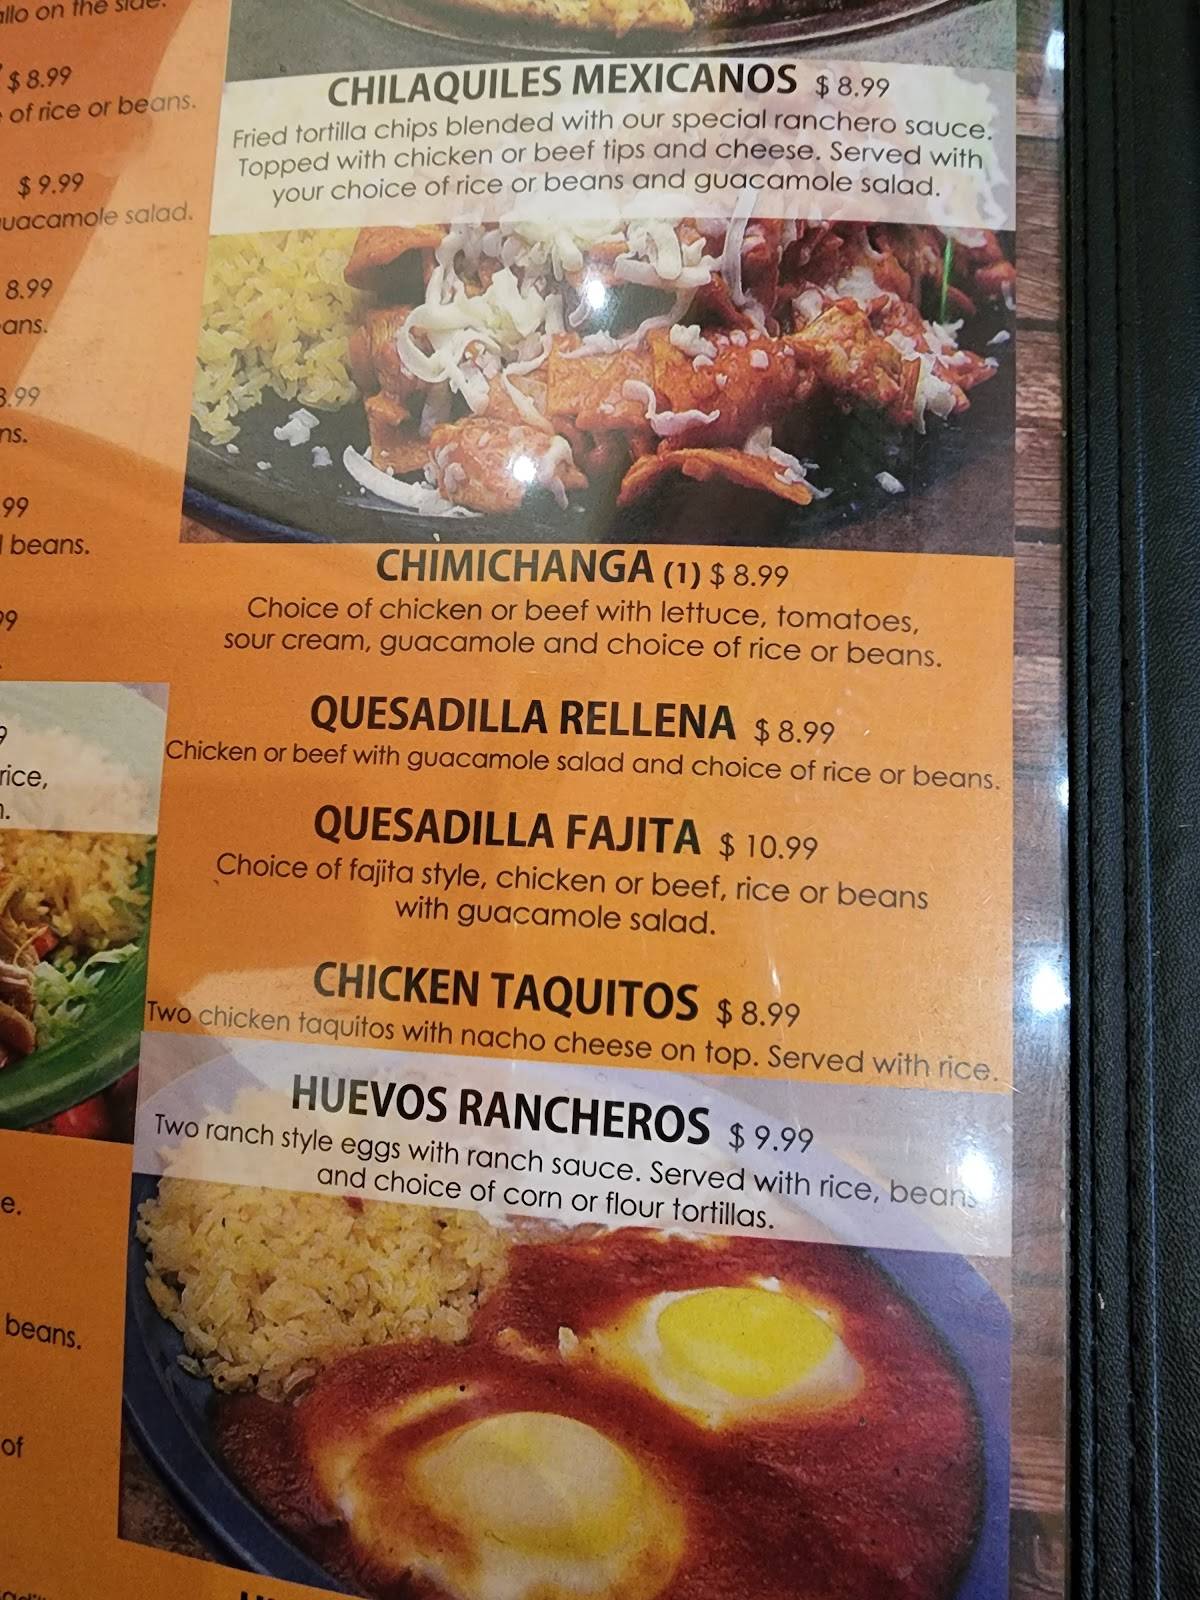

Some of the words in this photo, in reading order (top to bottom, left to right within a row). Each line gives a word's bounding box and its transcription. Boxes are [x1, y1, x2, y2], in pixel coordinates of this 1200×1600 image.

[35, 2, 64, 21] on
[72, 0, 107, 16] the
[7, 70, 21, 93] $
[26, 65, 72, 89] 8.99
[327, 65, 562, 107] CHILAQUILES
[572, 63, 797, 96] MEXICANOS
[815, 75, 829, 99] $
[837, 76, 890, 97] 8.99
[9, 103, 35, 123] of
[38, 100, 81, 122] rice
[88, 98, 112, 116] or
[118, 94, 197, 115] beans.
[233, 126, 287, 149] Fried
[295, 120, 367, 143] tortilla
[374, 116, 438, 142] chips
[445, 111, 554, 137] blended
[561, 109, 614, 131] with
[622, 111, 665, 130] our
[671, 108, 766, 133] special
[774, 111, 897, 134] ranchero
[905, 119, 993, 140] sauce.
[238, 152, 329, 180] Topped
[336, 150, 385, 170] with
[393, 145, 493, 168] chicken
[501, 146, 527, 163] or
[533, 140, 595, 162] beef
[602, 140, 644, 162] tips
[653, 139, 707, 160] and
[715, 138, 821, 162] cheese.
[830, 141, 922, 166] Served
[930, 148, 983, 170] with
[17, 175, 31, 199] $
[38, 172, 84, 195] 9.99
[272, 183, 324, 208] your
[330, 178, 417, 200] choice
[424, 176, 452, 197] of
[456, 174, 503, 195] rice
[511, 175, 537, 193] or
[544, 171, 624, 192] beans
[632, 168, 686, 190] and
[693, 169, 852, 194] guacamole
[861, 173, 940, 197] salad.
[0, 206, 118, 231] uacamole
[124, 201, 193, 223] salad.
[5, 278, 53, 300] 8.99
[0, 318, 48, 335] ans.
[10, 534, 90, 555] beans.
[376, 548, 654, 583] CHIMICHANGA
[663, 560, 701, 590] (1)
[710, 562, 725, 590] $
[733, 563, 790, 588] 8.99
[247, 596, 339, 620] Choice
[347, 598, 374, 619] of
[380, 599, 482, 621] chicken
[491, 603, 518, 621] or
[525, 599, 589, 622] beef
[597, 601, 652, 623] with
[660, 600, 768, 629] lettuce,
[777, 604, 920, 635] tomatoes,
[223, 630, 273, 650] sour
[281, 631, 372, 653] cream,
[380, 631, 535, 657] guacamole
[544, 634, 598, 655] and
[607, 635, 704, 657] choice
[713, 635, 743, 659] of
[749, 640, 801, 662] rice
[810, 643, 837, 663] or
[847, 640, 943, 668] beans.
[310, 695, 548, 734] QUESADILLA
[560, 700, 736, 740] RELLENA
[754, 718, 770, 746] $
[778, 720, 835, 745] 8.99
[0, 764, 48, 789] rice,
[166, 740, 257, 762] Chicken
[263, 745, 287, 762] or
[293, 743, 348, 765] beef
[353, 746, 400, 766] with
[407, 748, 550, 772] guacamole
[556, 751, 624, 773] salad
[632, 753, 683, 776] and
[691, 755, 782, 781] choice
[790, 759, 816, 782] of
[822, 764, 871, 784] rice
[879, 767, 905, 785] or
[912, 766, 1001, 791] beans.
[313, 804, 554, 849] QUESADILLA
[566, 814, 702, 855] FAJITA
[718, 832, 735, 862] $
[746, 834, 818, 860] 10.99
[216, 852, 308, 879] Choice
[316, 857, 342, 880] of
[349, 858, 414, 888] fajita
[422, 860, 487, 891] style,
[496, 865, 605, 893] chicken
[615, 874, 644, 895] or
[652, 872, 727, 902] beef,
[736, 875, 790, 903] rice
[800, 884, 826, 904] or
[837, 881, 929, 910] beans
[395, 895, 449, 921] with
[457, 905, 621, 929] guacamole
[630, 908, 716, 936] salad.
[313, 961, 480, 1007] CHICKEN
[490, 971, 699, 1022] TAQUITOS
[716, 998, 732, 1028] $
[742, 1001, 801, 1028] 8.99
[146, 1000, 191, 1025] Two
[199, 1004, 291, 1032] chicken
[298, 1011, 394, 1040] taquitos
[402, 1021, 453, 1045] with
[461, 1028, 546, 1053] nacho
[554, 1031, 652, 1059] cheese
[661, 1041, 696, 1062] on
[704, 1039, 759, 1069] top.
[768, 1044, 864, 1074] Served
[873, 1052, 930, 1077] with
[939, 1055, 999, 1083] rice.
[291, 1074, 447, 1123] HUEVOS
[459, 1088, 710, 1145] RANCHEROS
[728, 1122, 745, 1154] $
[754, 1125, 815, 1153] 9.99
[155, 1113, 199, 1138] Two
[205, 1120, 274, 1147] ranch
[281, 1125, 333, 1155] style
[340, 1134, 401, 1162] eggs
[408, 1140, 459, 1166] with
[467, 1144, 543, 1173] ranch
[552, 1152, 640, 1184] sauce.
[649, 1160, 745, 1192] Served
[754, 1169, 810, 1197] with
[820, 1174, 880, 1203] rice,
[317, 1164, 366, 1190] and
[374, 1169, 462, 1199] choice
[471, 1179, 496, 1203] of
[503, 1185, 562, 1211] corn
[571, 1191, 598, 1212] or
[605, 1190, 665, 1220] flour
[673, 1195, 775, 1231] tortillas.
[5, 1312, 81, 1350] beans.
[0, 1436, 24, 1458] of
